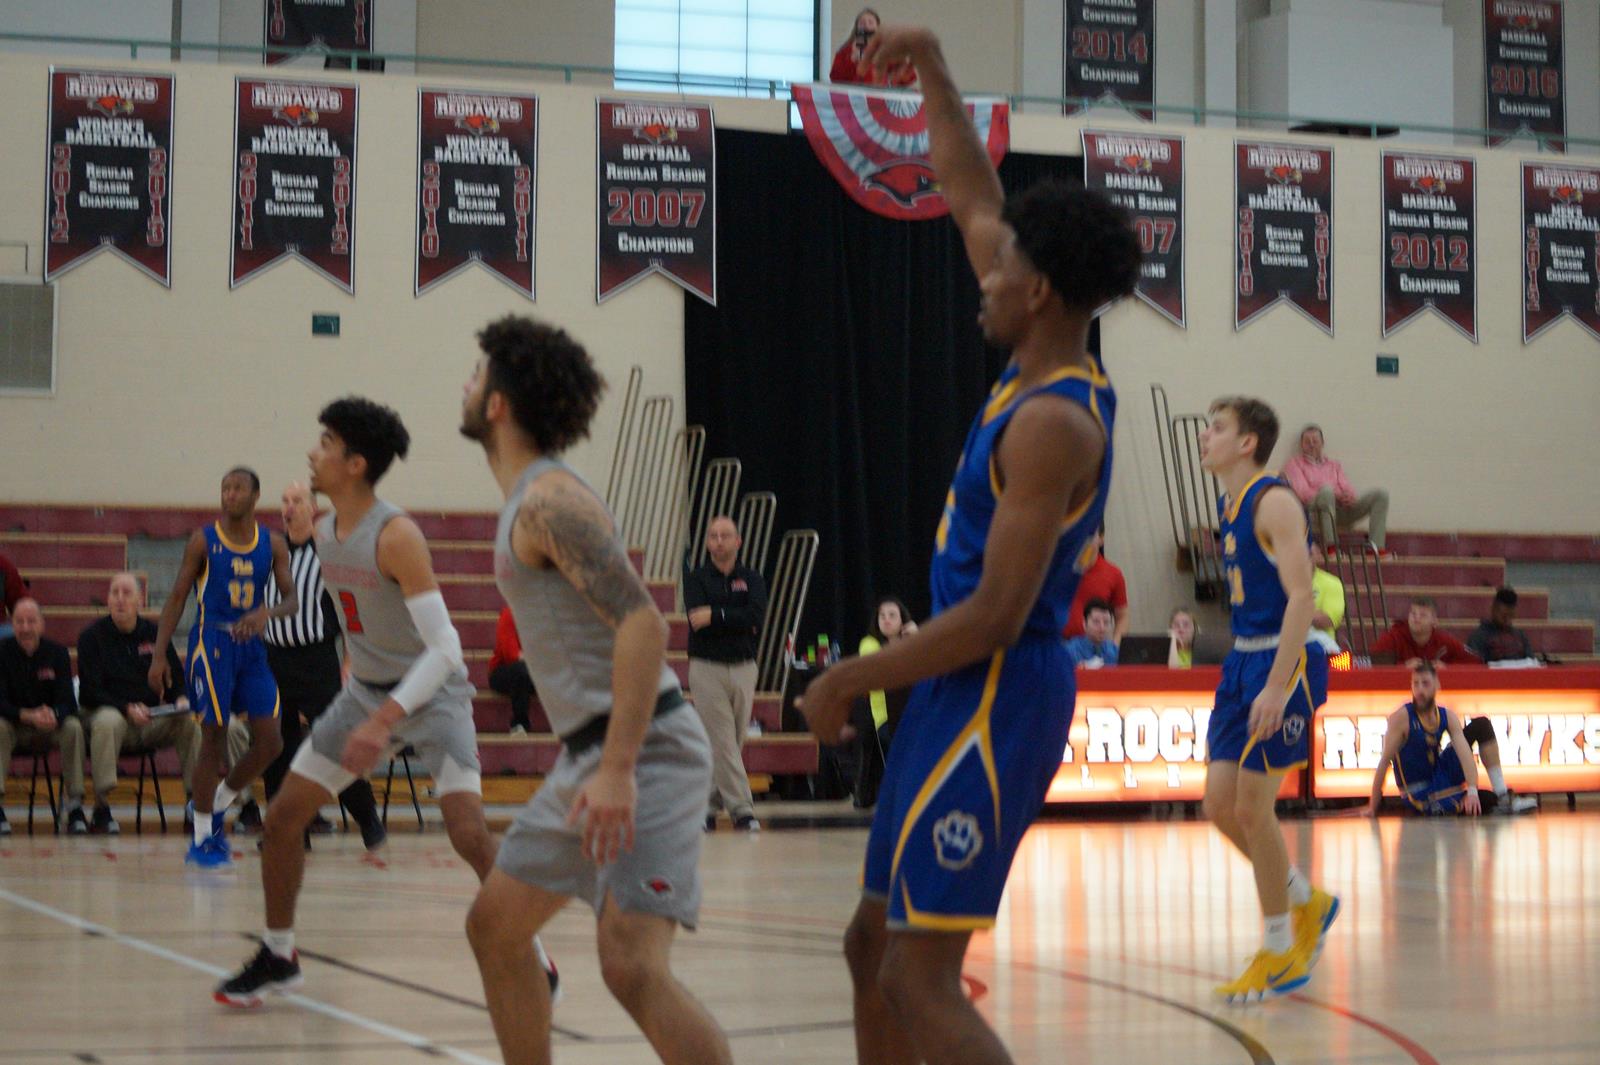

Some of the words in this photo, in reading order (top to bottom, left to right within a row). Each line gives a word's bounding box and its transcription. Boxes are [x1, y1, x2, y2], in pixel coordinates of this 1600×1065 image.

[1073, 27, 1147, 64] 2014
[1081, 64, 1139, 84] CHAMPIONS
[1491, 64, 1558, 98] 2016
[1500, 98, 1550, 118] CHAMPIONS
[78, 116, 144, 134] WOMEN'S
[264, 125, 329, 143] WOMEN'S
[65, 129, 156, 148] BASKETBALL
[251, 137, 340, 157] BASKETBALL
[446, 134, 509, 150] WOMEN'S
[435, 147, 521, 166] BASKETBALL
[622, 144, 690, 162] SOFTBALL
[86, 162, 133, 180] REGULAR
[272, 170, 318, 188] REGULAR
[606, 163, 658, 182] REGULAR
[662, 164, 706, 183] SEASON
[89, 180, 130, 195] SEASON
[454, 179, 500, 198] REGULAR
[1105, 173, 1163, 192] BASEBALL
[79, 196, 139, 210] CHAMPIONS
[275, 188, 315, 203] SEASON
[457, 197, 496, 211] SEASON
[1139, 194, 1177, 212] SEASON
[1248, 193, 1320, 213] BASKETBALL
[1402, 193, 1456, 211] BASEBALL
[265, 203, 324, 218] CHAMPIONS
[608, 186, 706, 228] 2007
[448, 207, 505, 226] CHAMPIONS
[1388, 209, 1430, 228] REGULAR
[1433, 212, 1468, 231] SEASON
[1133, 215, 1176, 254] 07
[1265, 224, 1304, 241] REGULAR
[618, 232, 694, 254] CHAMPIONS
[1268, 240, 1301, 254] SEASON
[1391, 232, 1469, 272] 2012
[1550, 242, 1586, 260] REGULAR
[1260, 250, 1308, 268] CHAMPIONS
[1553, 257, 1583, 270] SEASON
[1400, 273, 1460, 295] CHAMPIONS
[1546, 268, 1590, 285] CHAMPIONS
[338, 590, 364, 635] 2
